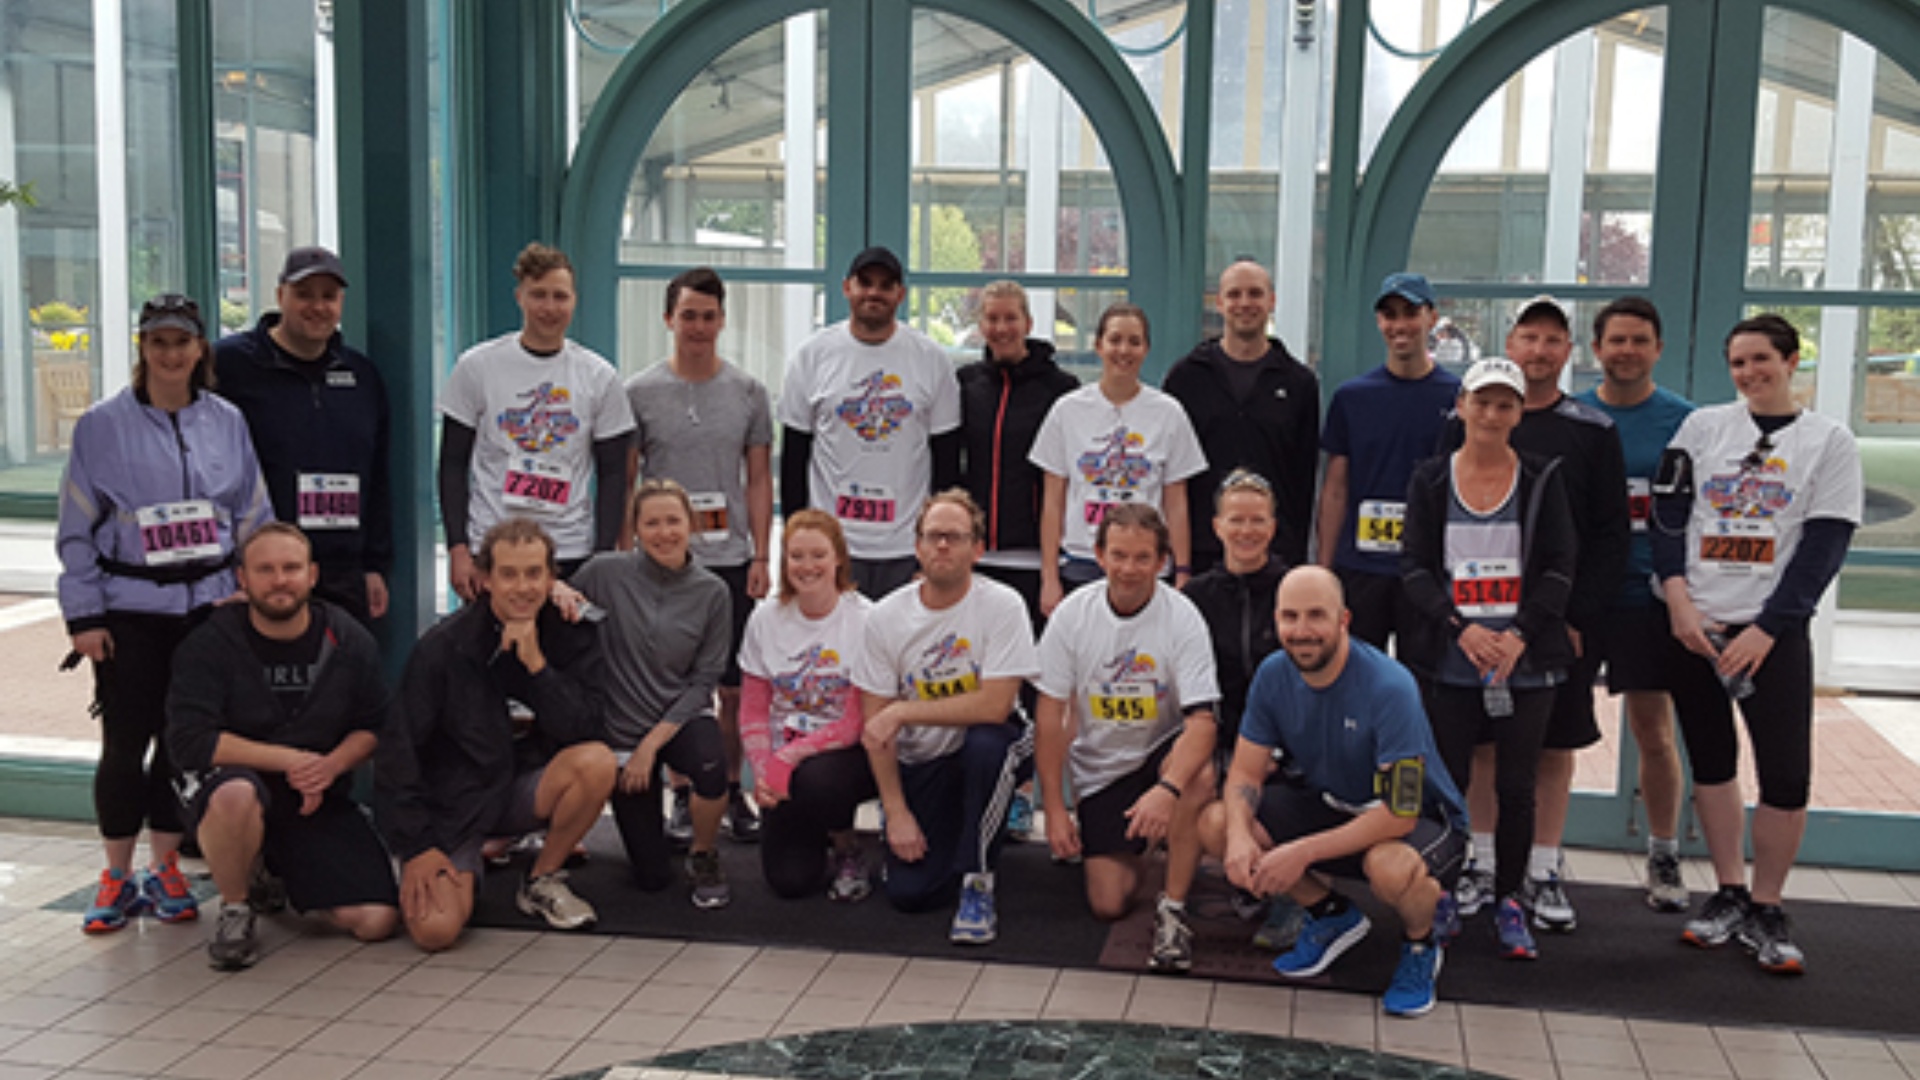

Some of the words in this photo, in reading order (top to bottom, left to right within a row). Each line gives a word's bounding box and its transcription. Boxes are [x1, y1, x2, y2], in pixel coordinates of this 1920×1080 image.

[507, 471, 566, 501] 7207
[838, 496, 890, 521] 7931
[143, 521, 216, 552] 10461
[1702, 536, 1769, 561] 2207
[1458, 579, 1519, 603] 5147
[1101, 697, 1145, 719] 545
